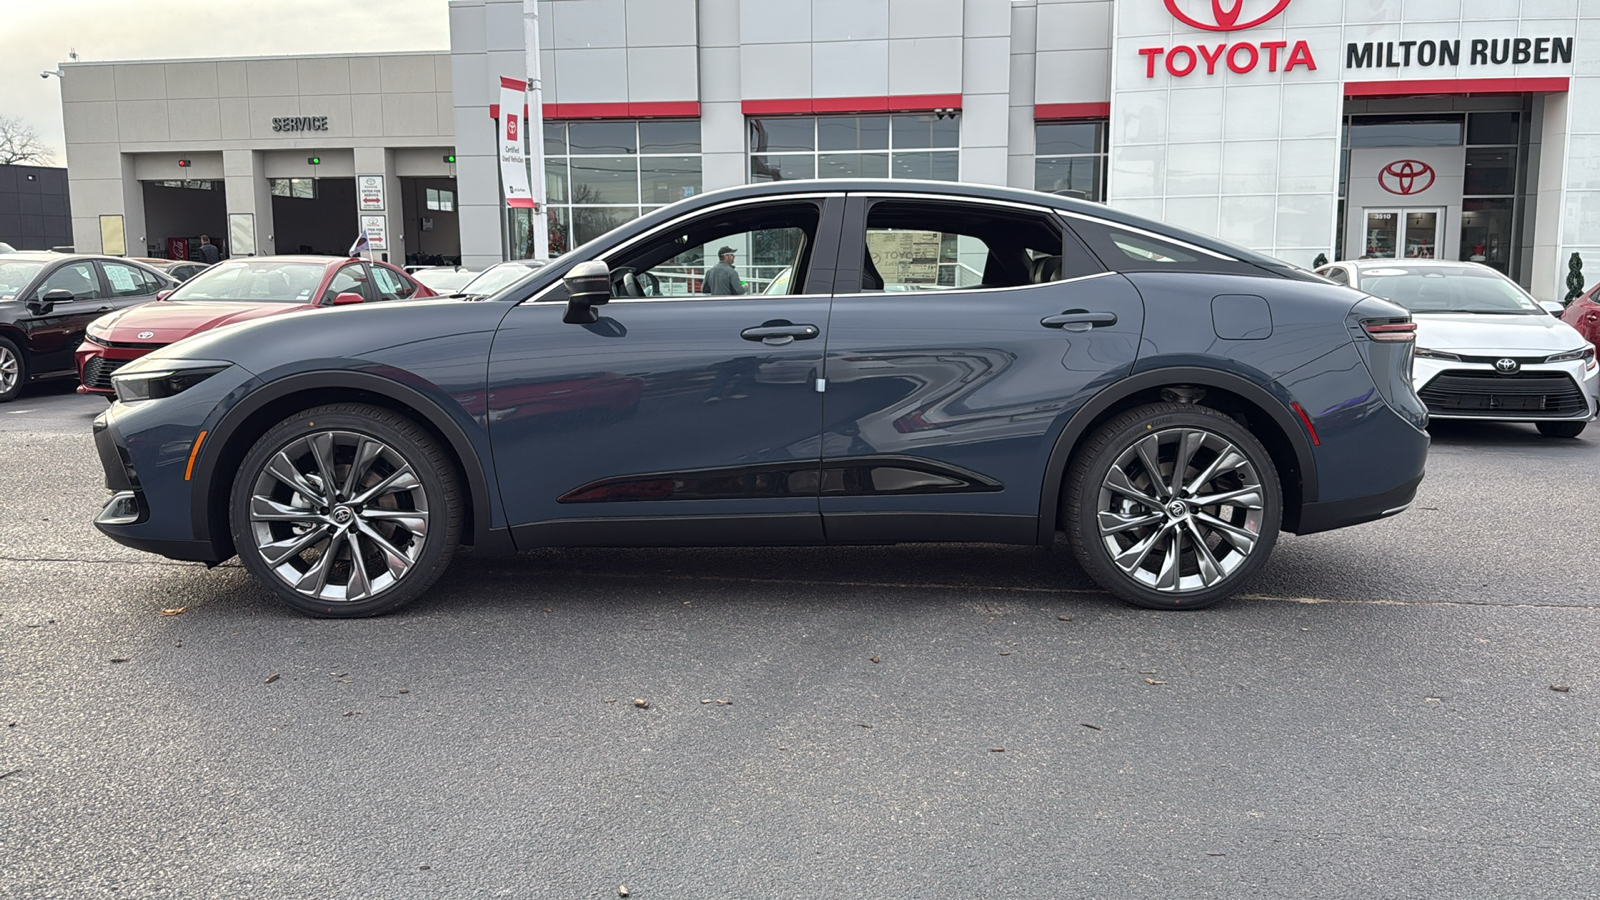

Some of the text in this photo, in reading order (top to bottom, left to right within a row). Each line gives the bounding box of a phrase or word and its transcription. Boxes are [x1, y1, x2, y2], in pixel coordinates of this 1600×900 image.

[1138, 40, 1317, 78] TOYOTA
[1346, 37, 1573, 69] MILTON RUBEN
[271, 115, 329, 132] SERVICE
[884, 251, 926, 260] TOYOTA
